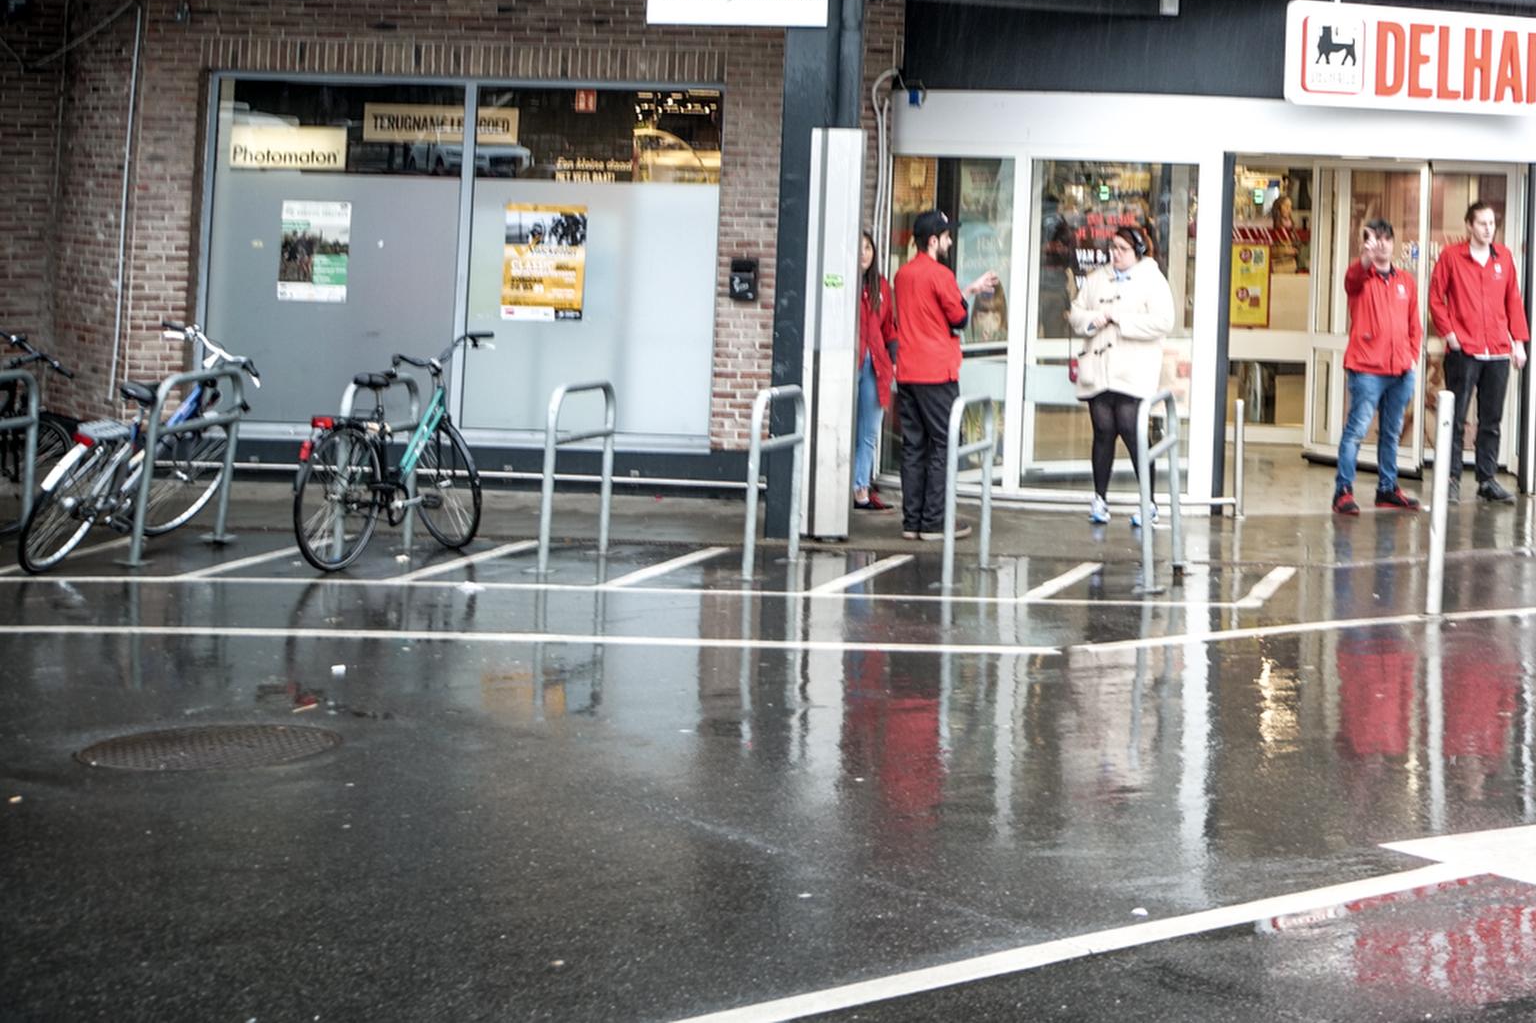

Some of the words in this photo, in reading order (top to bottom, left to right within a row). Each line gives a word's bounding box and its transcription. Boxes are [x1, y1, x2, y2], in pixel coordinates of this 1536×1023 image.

[373, 113, 446, 134] TERUGNAME
[449, 116, 511, 136] LEGOED
[231, 145, 338, 165] Photomaton
